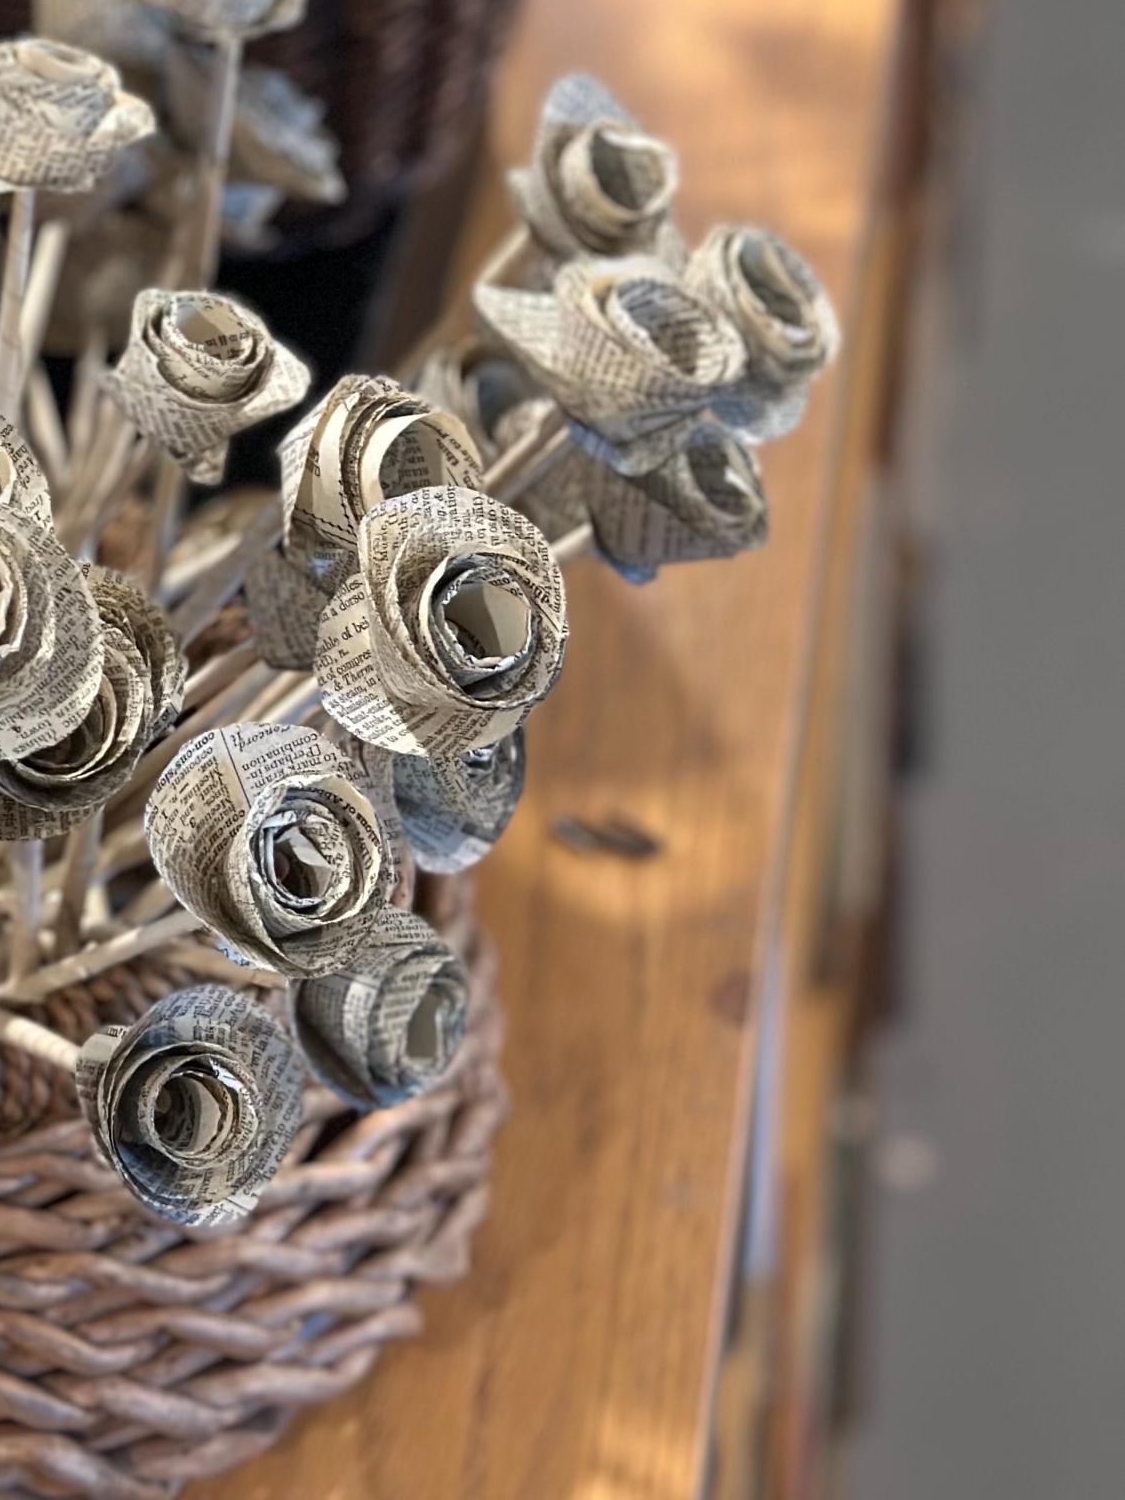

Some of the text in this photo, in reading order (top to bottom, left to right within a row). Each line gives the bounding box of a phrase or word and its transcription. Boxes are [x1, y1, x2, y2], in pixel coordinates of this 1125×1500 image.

[341, 627, 353, 641] of
[241, 732, 319, 772] combination
[323, 751, 338, 763] to
